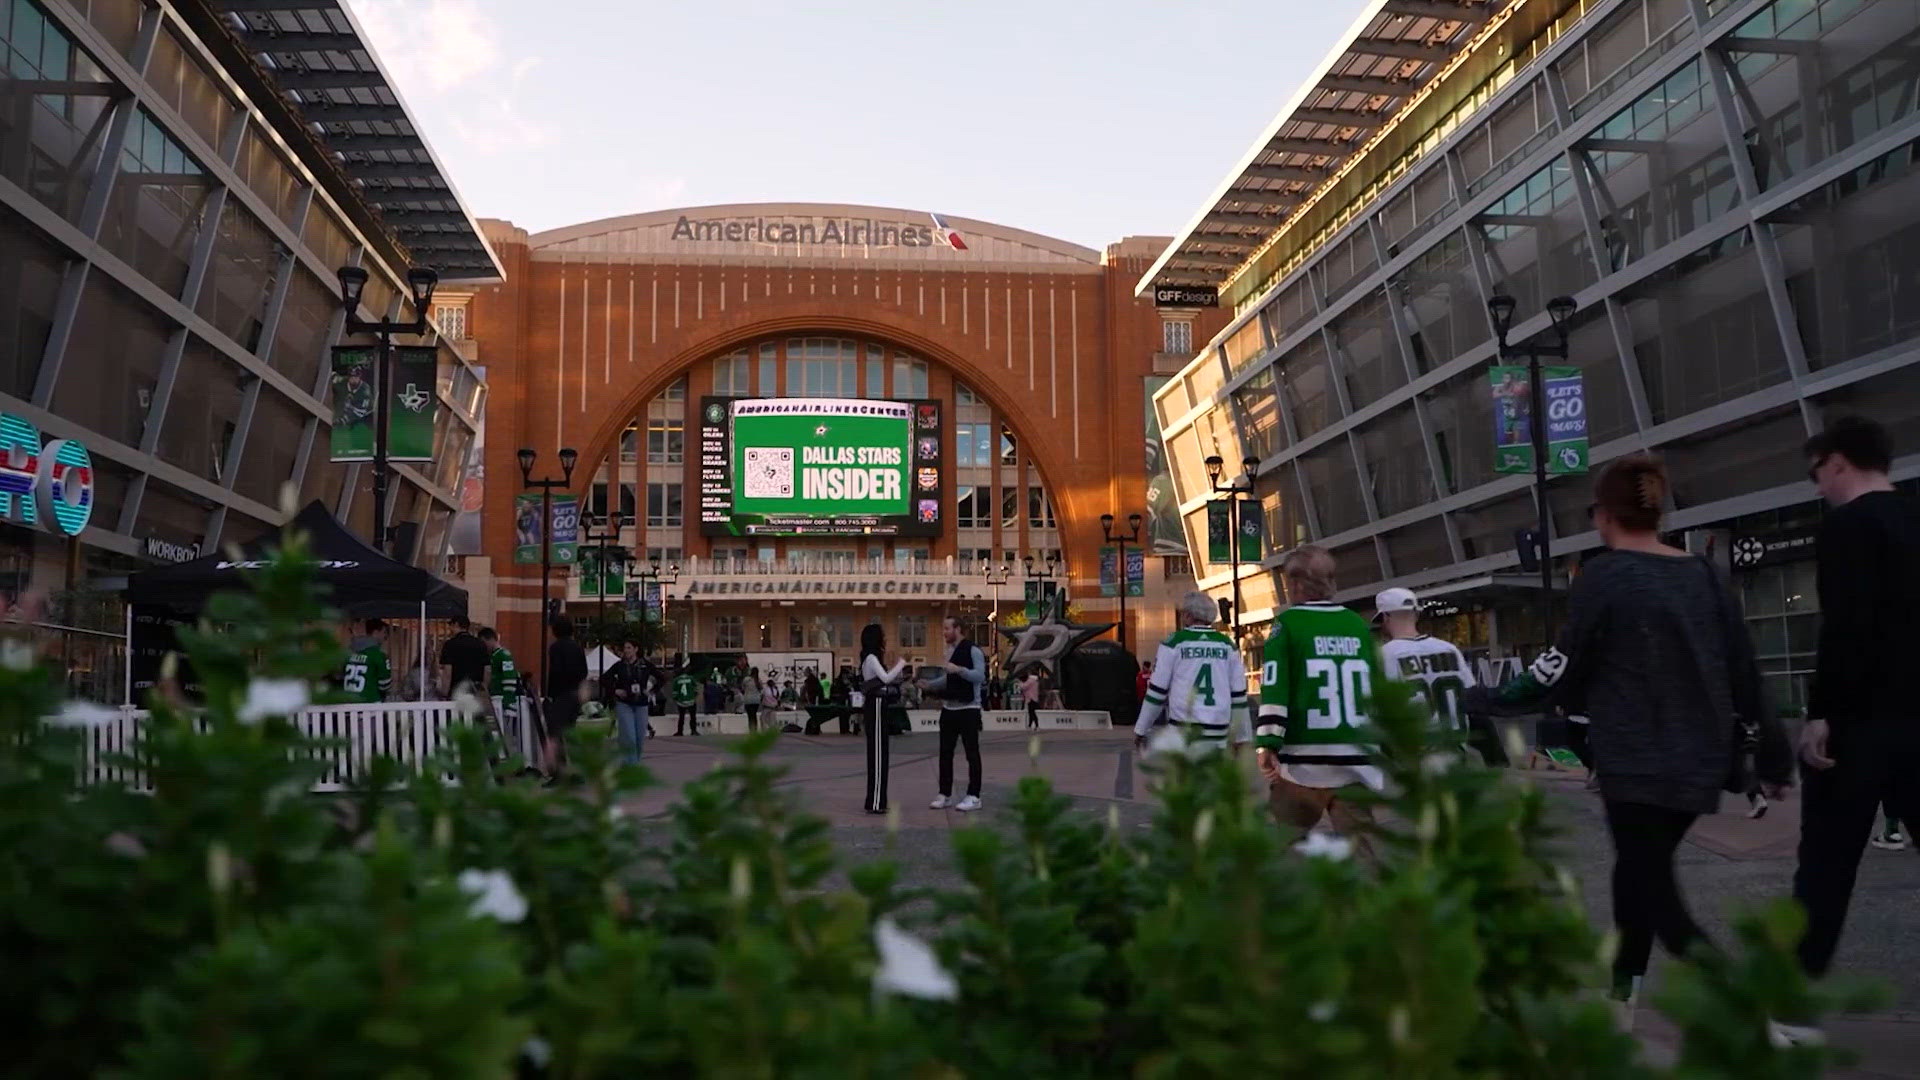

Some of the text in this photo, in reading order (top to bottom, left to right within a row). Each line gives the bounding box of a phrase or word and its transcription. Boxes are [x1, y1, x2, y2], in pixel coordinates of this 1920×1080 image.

[1548, 397, 1583, 420] GO
[802, 446, 901, 465] DALLAS STARS
[802, 467, 901, 500] INSIDER
[553, 514, 576, 529] GO
[1126, 562, 1143, 572] GO
[1180, 646, 1229, 660] HEISKANEN
[1313, 635, 1361, 658] BISHOP
[343, 663, 368, 693] 25
[1193, 662, 1216, 706] 4
[1306, 658, 1373, 731] 30
